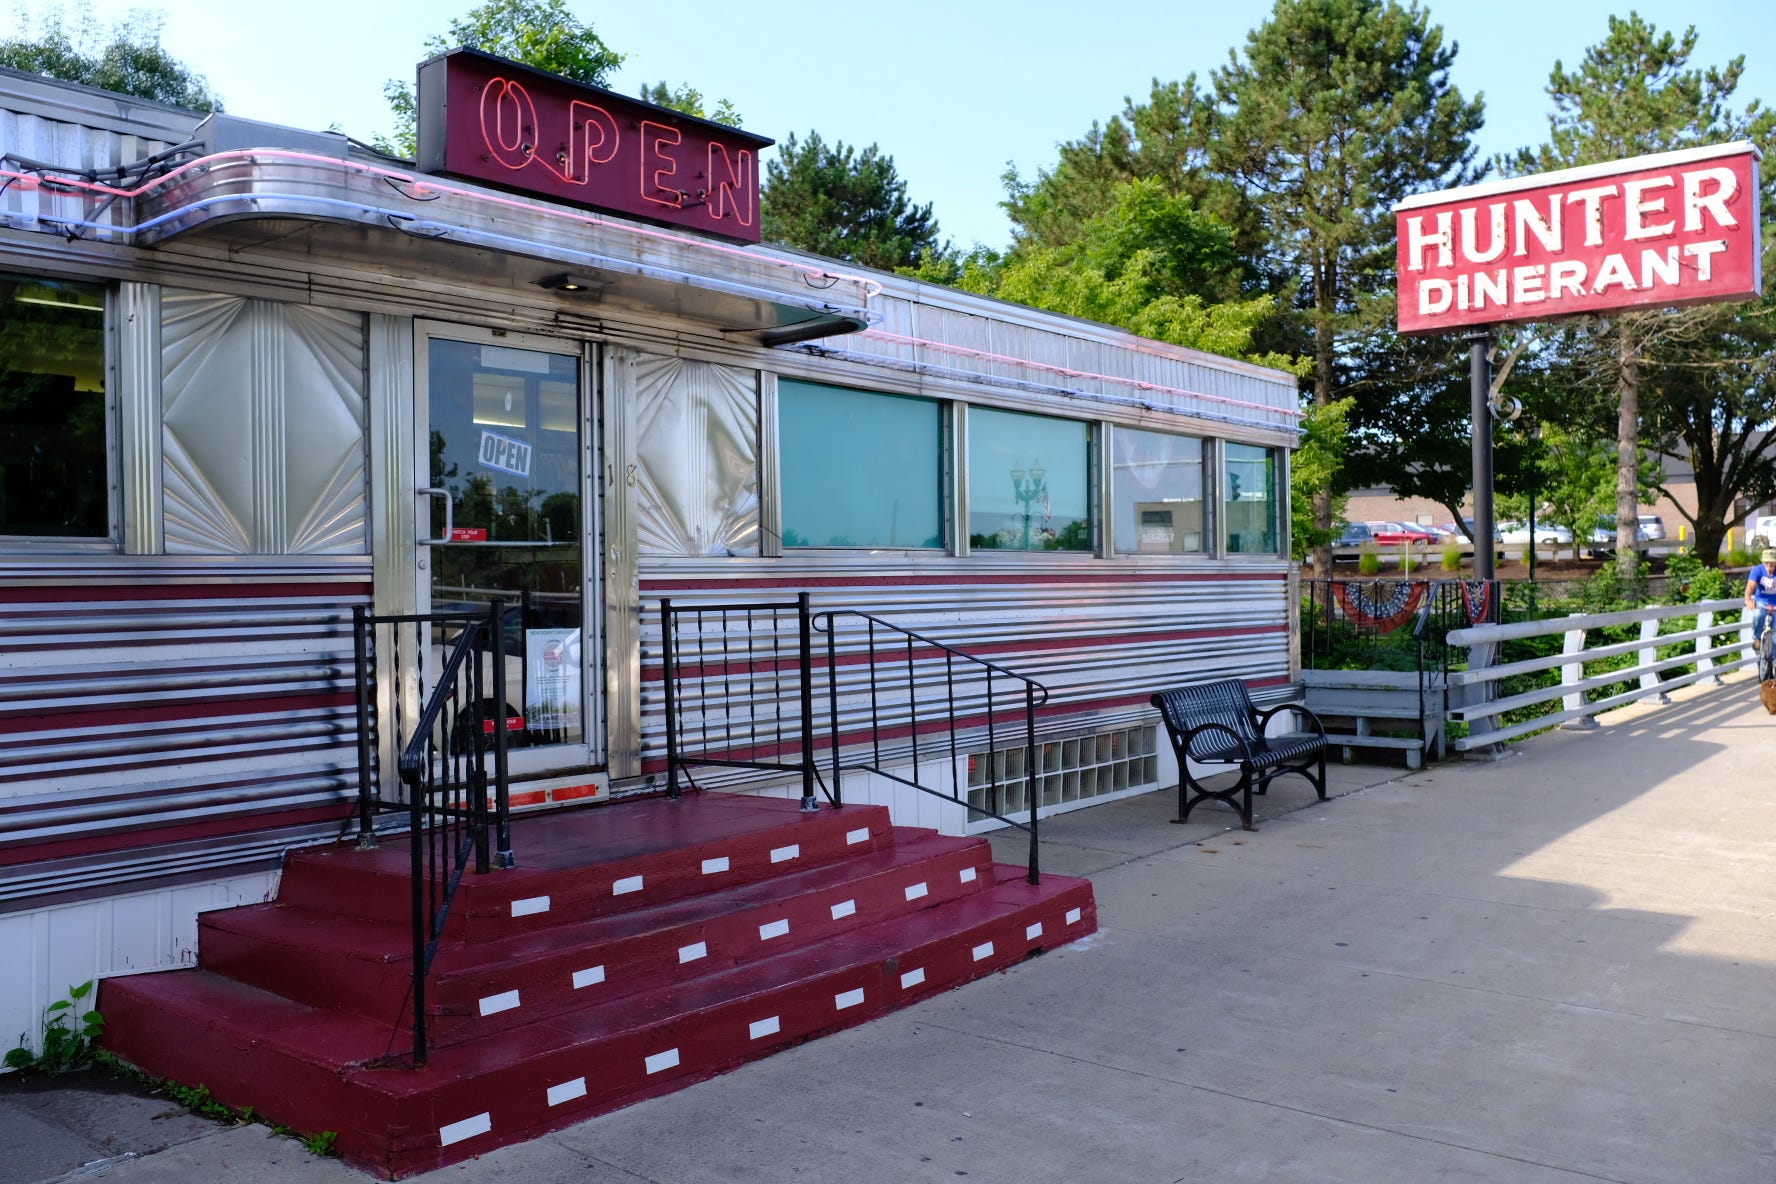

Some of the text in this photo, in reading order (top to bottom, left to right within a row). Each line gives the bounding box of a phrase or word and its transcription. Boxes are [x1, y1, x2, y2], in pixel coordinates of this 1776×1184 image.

[480, 77, 752, 226] OPEN
[1406, 166, 1740, 272] HUNTER
[1417, 239, 1729, 315] DINERANT
[482, 434, 528, 473] OPEN
